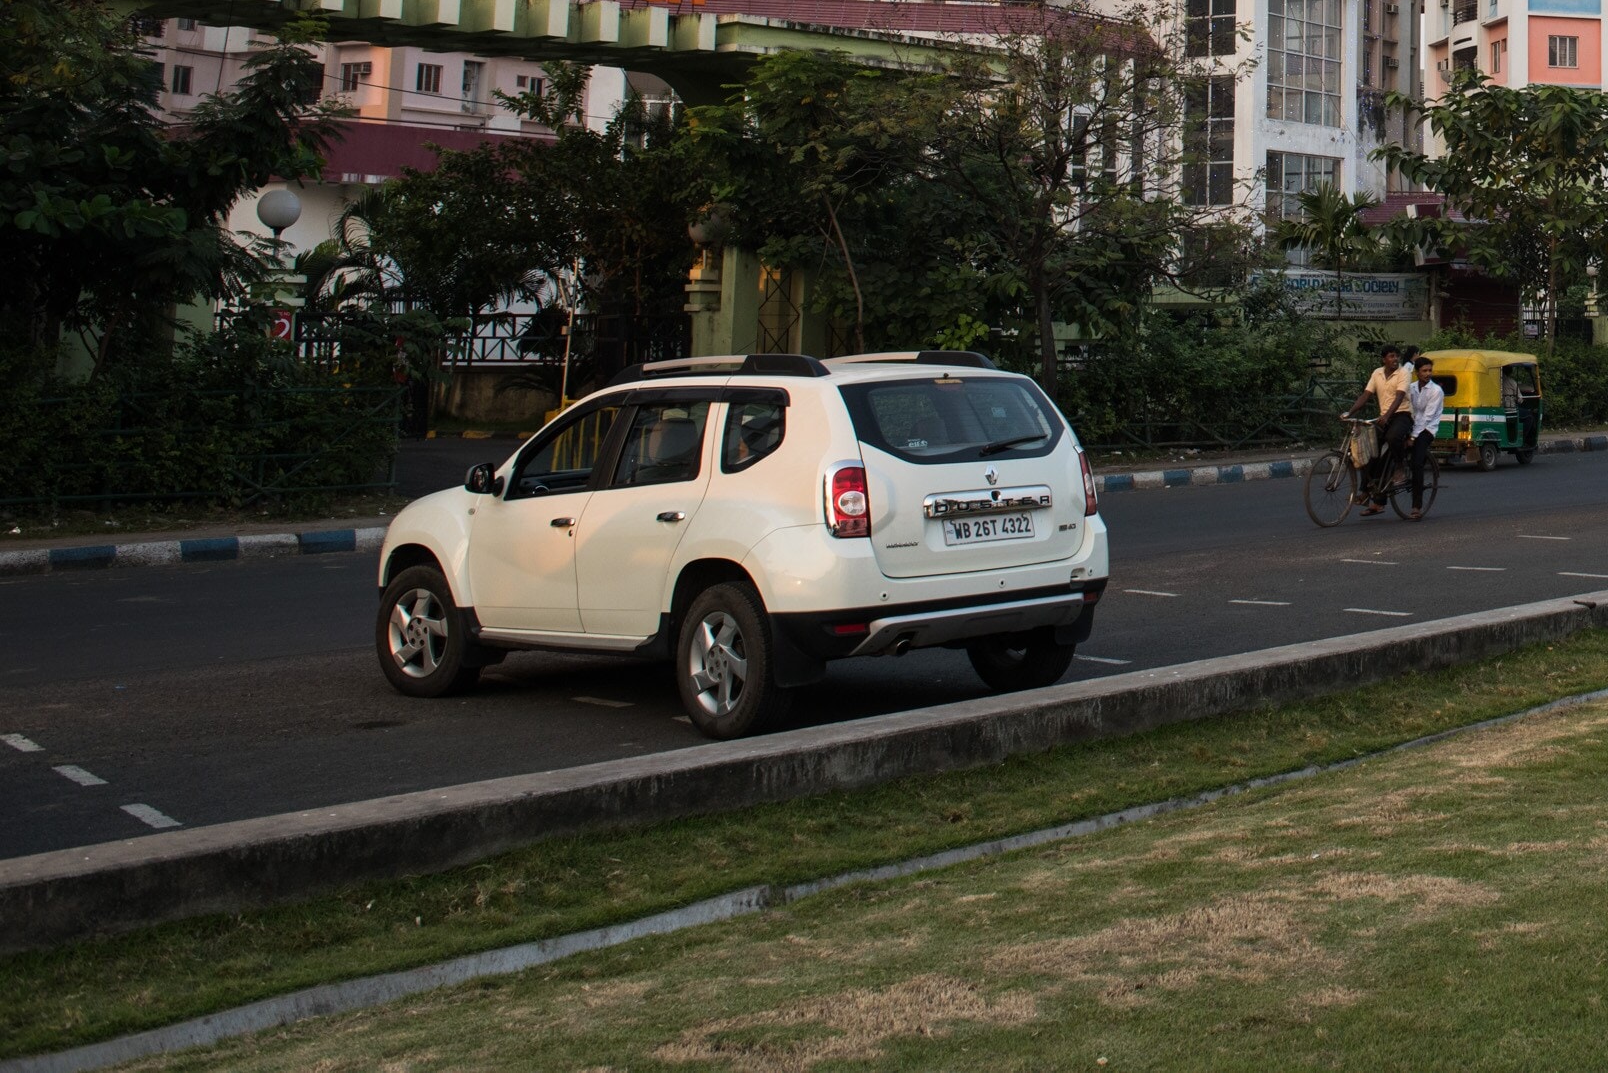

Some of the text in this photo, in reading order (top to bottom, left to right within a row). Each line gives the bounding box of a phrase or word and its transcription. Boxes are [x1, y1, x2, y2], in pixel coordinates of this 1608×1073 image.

[953, 517, 1031, 539] WB 26T 4322
